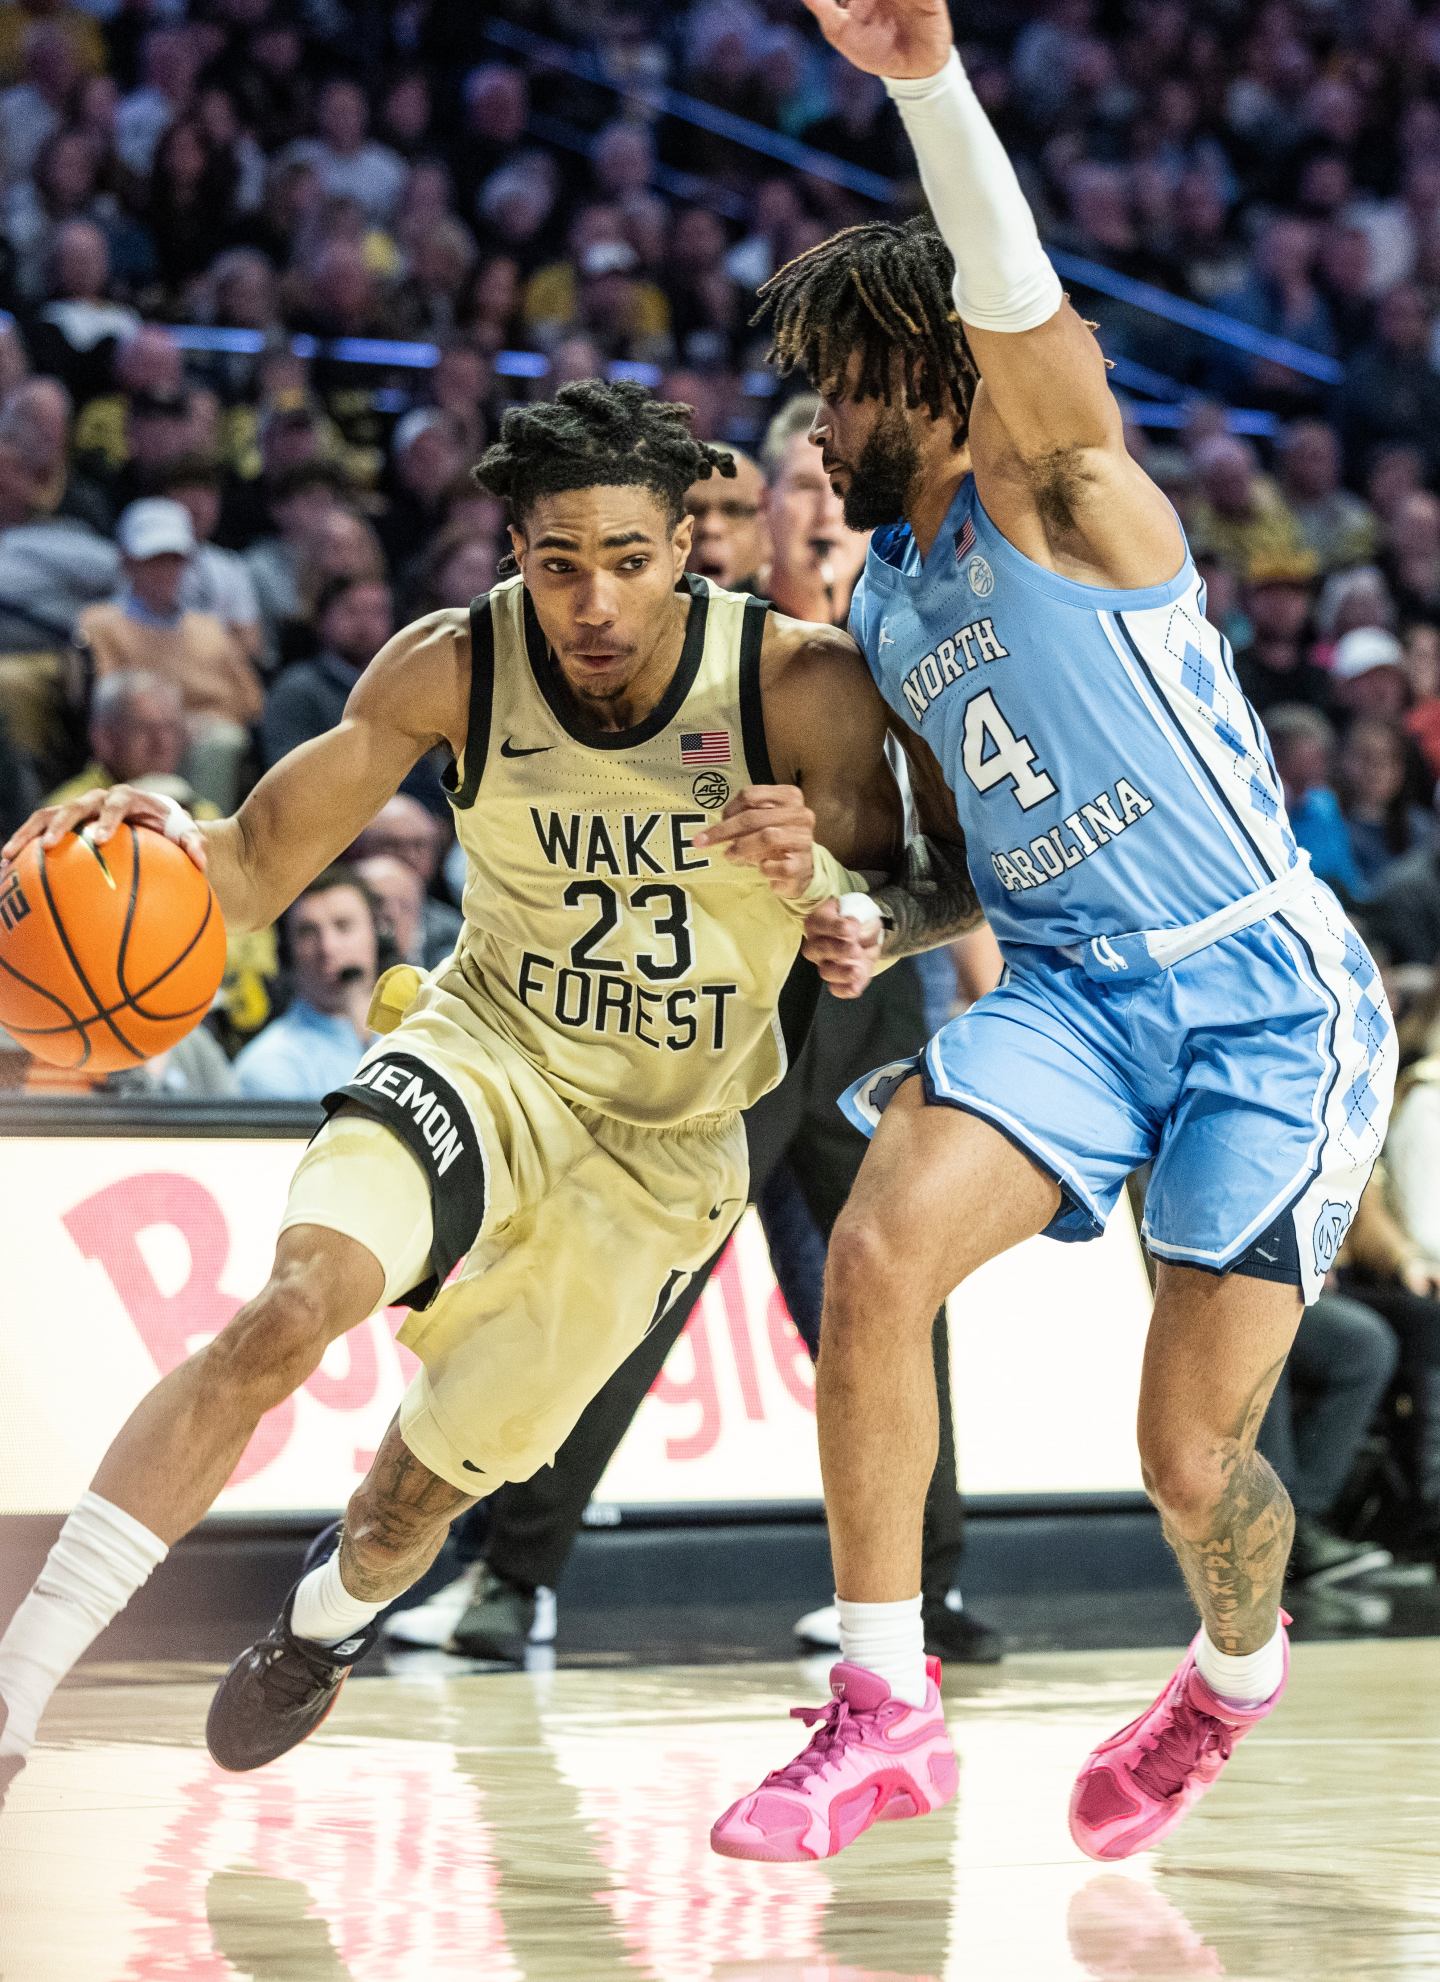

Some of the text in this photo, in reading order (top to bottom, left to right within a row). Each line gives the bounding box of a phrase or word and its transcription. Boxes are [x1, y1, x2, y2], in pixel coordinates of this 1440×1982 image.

[901, 617, 1010, 722] NORTH
[697, 782, 728, 794] ACC
[960, 686, 1060, 813] 4
[529, 806, 711, 876] WAKE
[562, 879, 695, 981] 23
[518, 951, 738, 1052] FOREST
